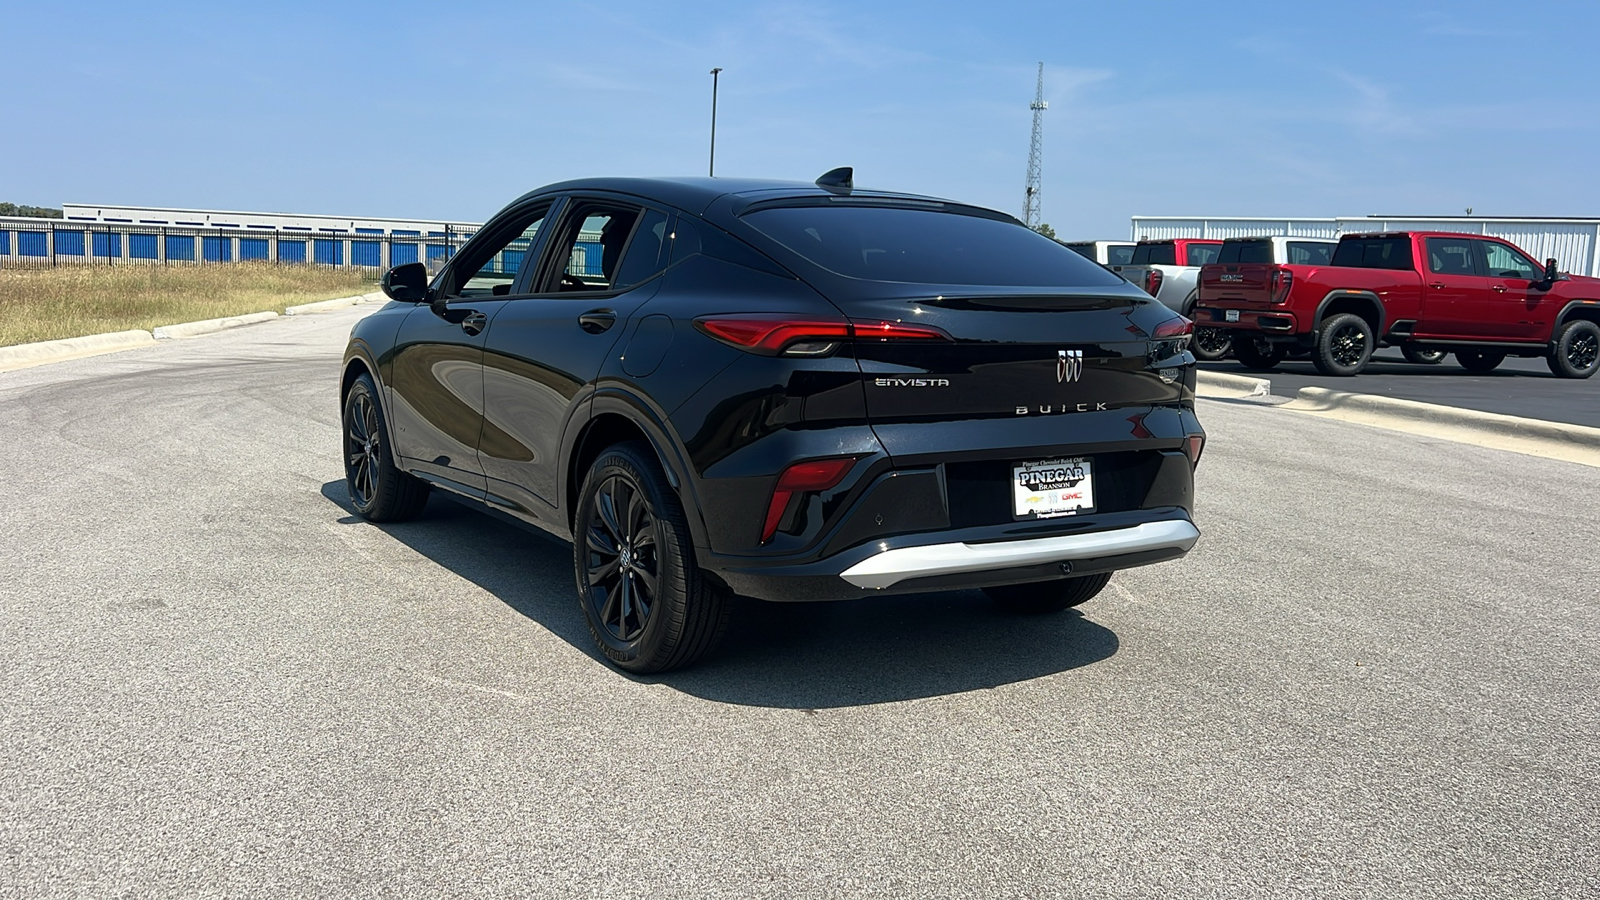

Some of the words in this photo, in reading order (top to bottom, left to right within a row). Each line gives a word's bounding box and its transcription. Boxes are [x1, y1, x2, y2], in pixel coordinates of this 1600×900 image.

[875, 378, 949, 387] ENVISTA
[1015, 402, 1107, 415] BUICK
[1020, 468, 1084, 486] PINEGAR
[1038, 482, 1071, 491] BRANSON
[1061, 492, 1082, 500] GMC
